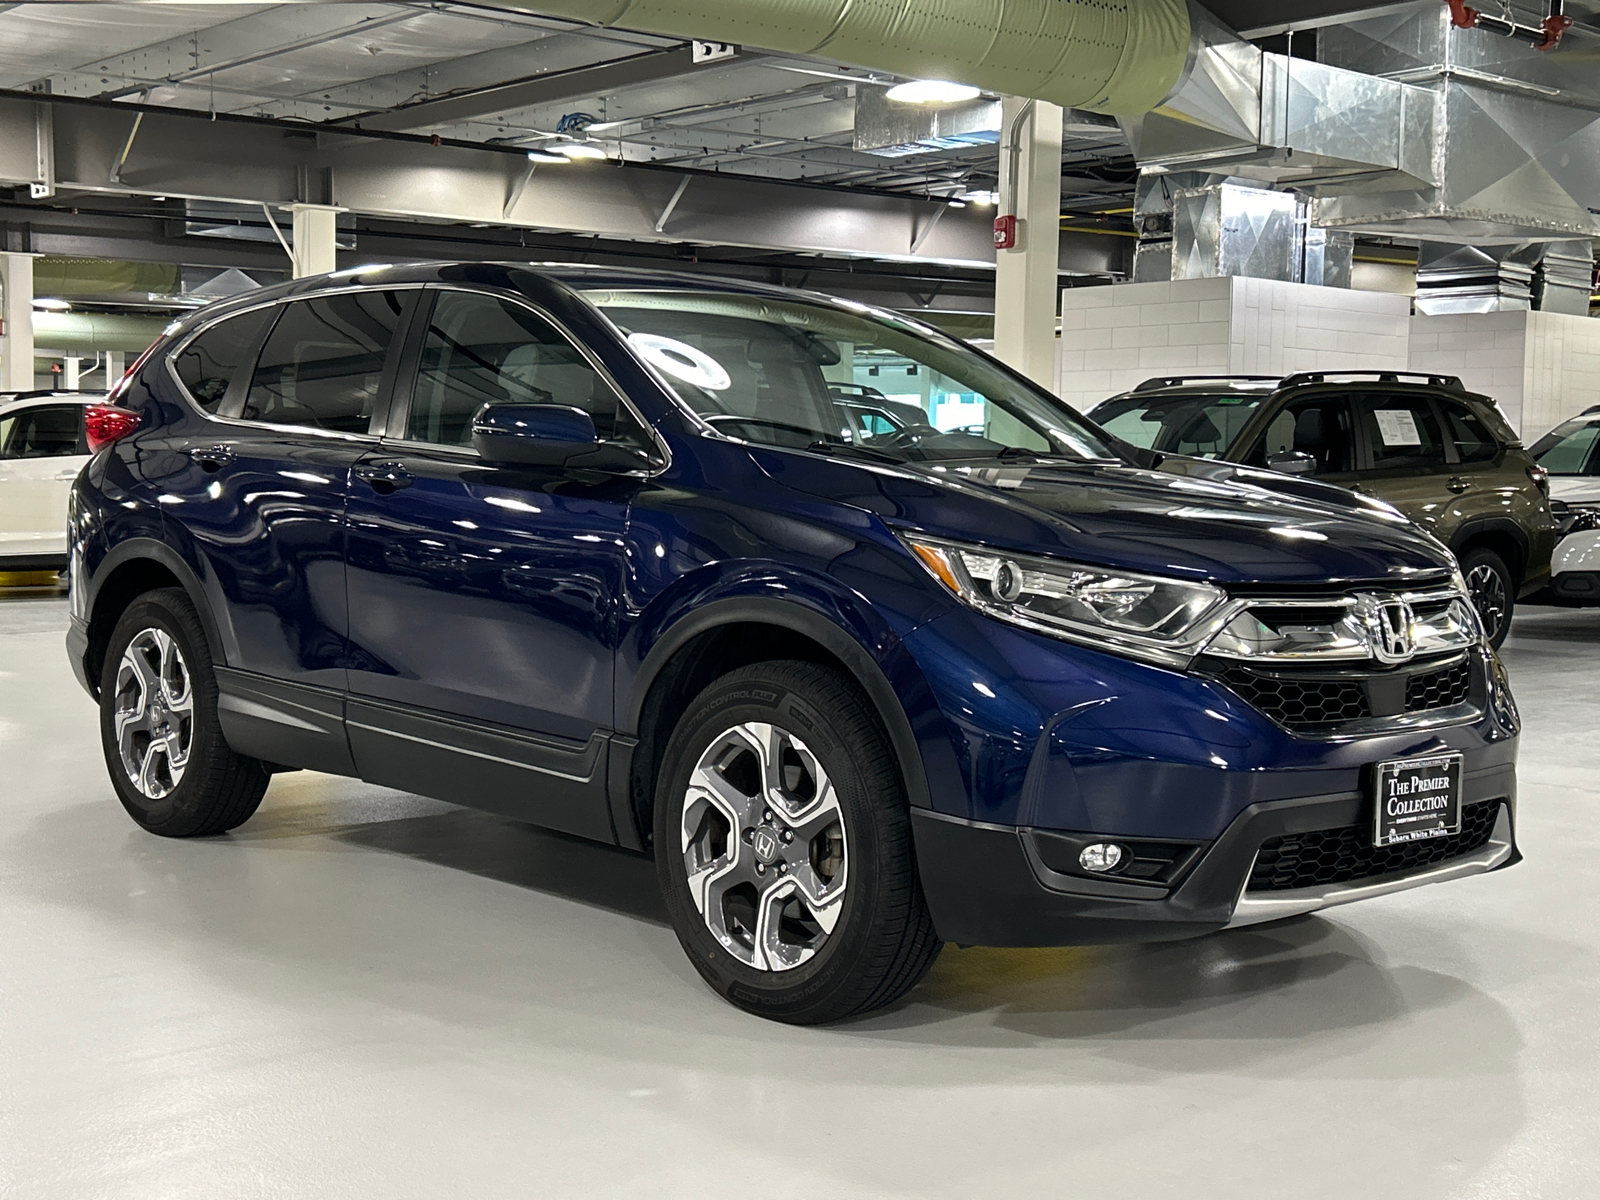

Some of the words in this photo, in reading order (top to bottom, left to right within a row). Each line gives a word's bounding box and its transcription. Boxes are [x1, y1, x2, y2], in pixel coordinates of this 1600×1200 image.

[676, 704, 710, 748] TRACTION
[710, 690, 751, 709] CONTROL
[1388, 778, 1409, 796] THE
[1410, 776, 1450, 793] PREMIER
[1387, 795, 1449, 816] COLLECTION
[804, 953, 844, 996] TRACTION
[759, 990, 804, 1005] CONTROL
